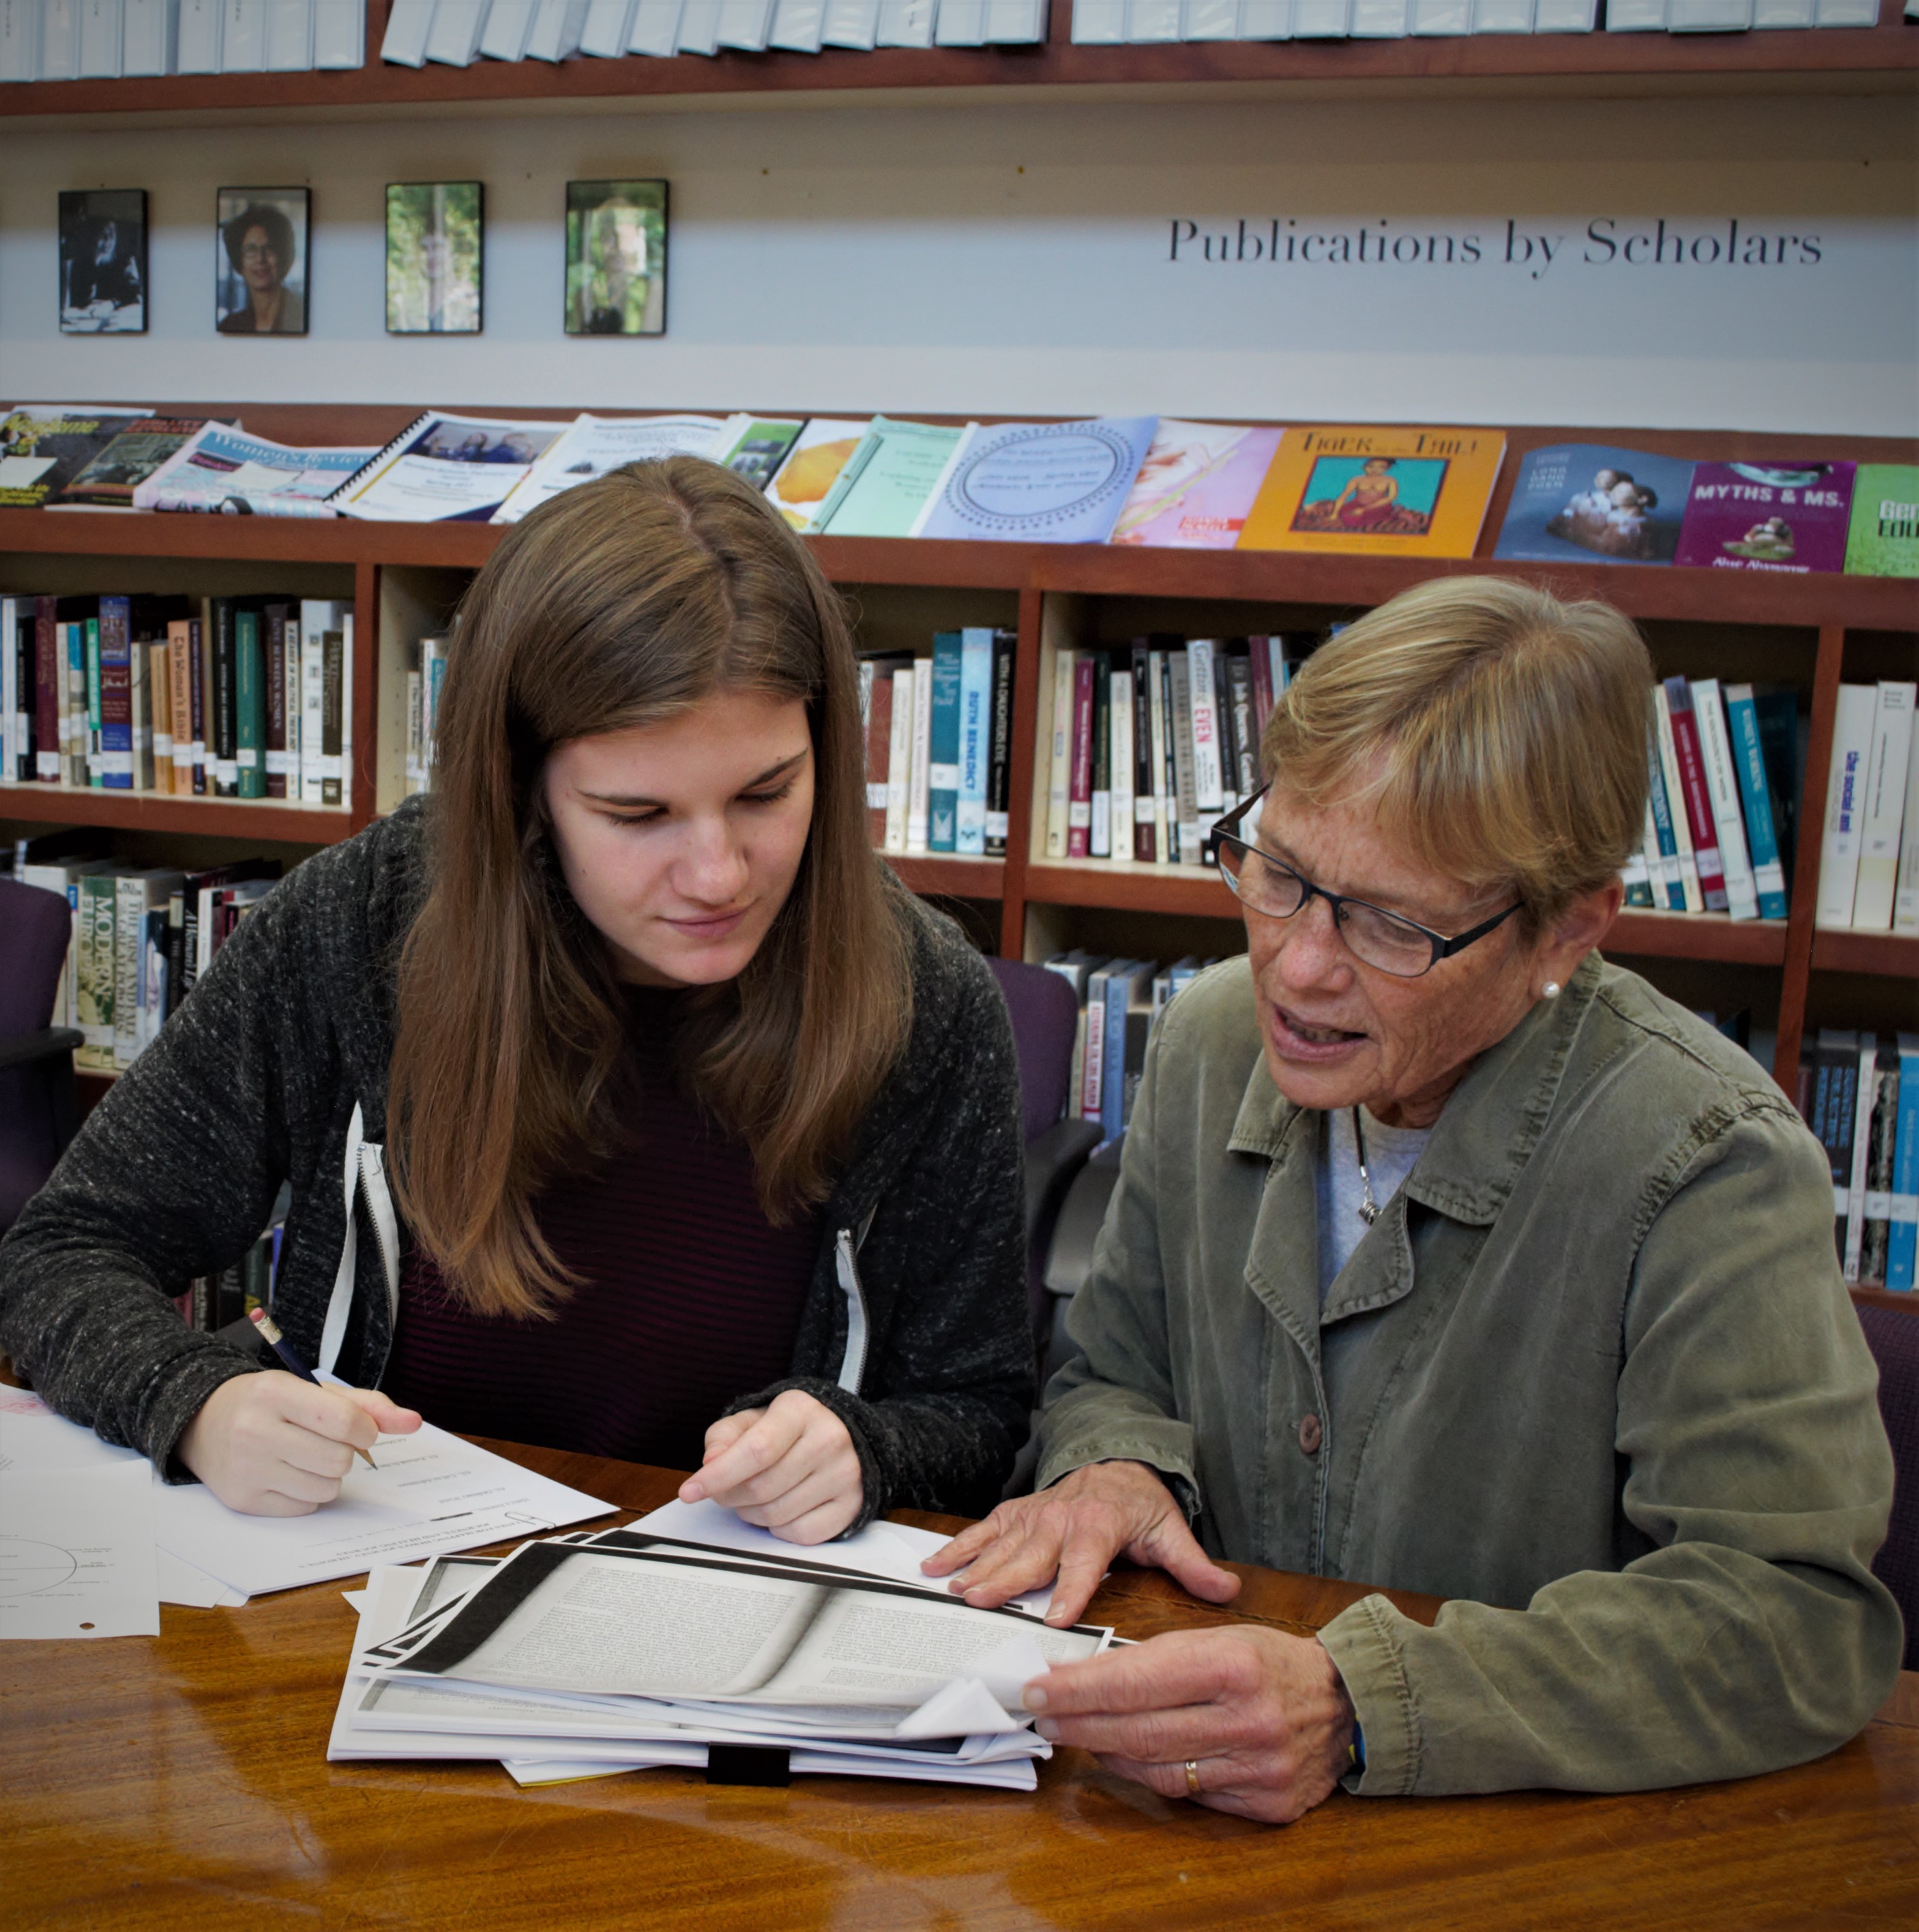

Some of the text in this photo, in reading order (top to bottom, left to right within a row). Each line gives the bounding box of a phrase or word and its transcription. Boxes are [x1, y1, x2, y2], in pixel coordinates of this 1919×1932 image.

[1165, 218, 1823, 281] Publications by Scholars
[1302, 432, 1373, 452] TIGER
[1694, 484, 1845, 509] MYTHS & MS.
[173, 636, 188, 740] The Woman's Bible
[272, 645, 281, 688] BETWEEN
[272, 691, 281, 729] WOMEN
[1193, 708, 1212, 742] EVEN
[964, 729, 977, 789] BENEDICT
[1840, 775, 1856, 811] social
[80, 895, 94, 976] EUROPE
[93, 896, 112, 996] MODERN
